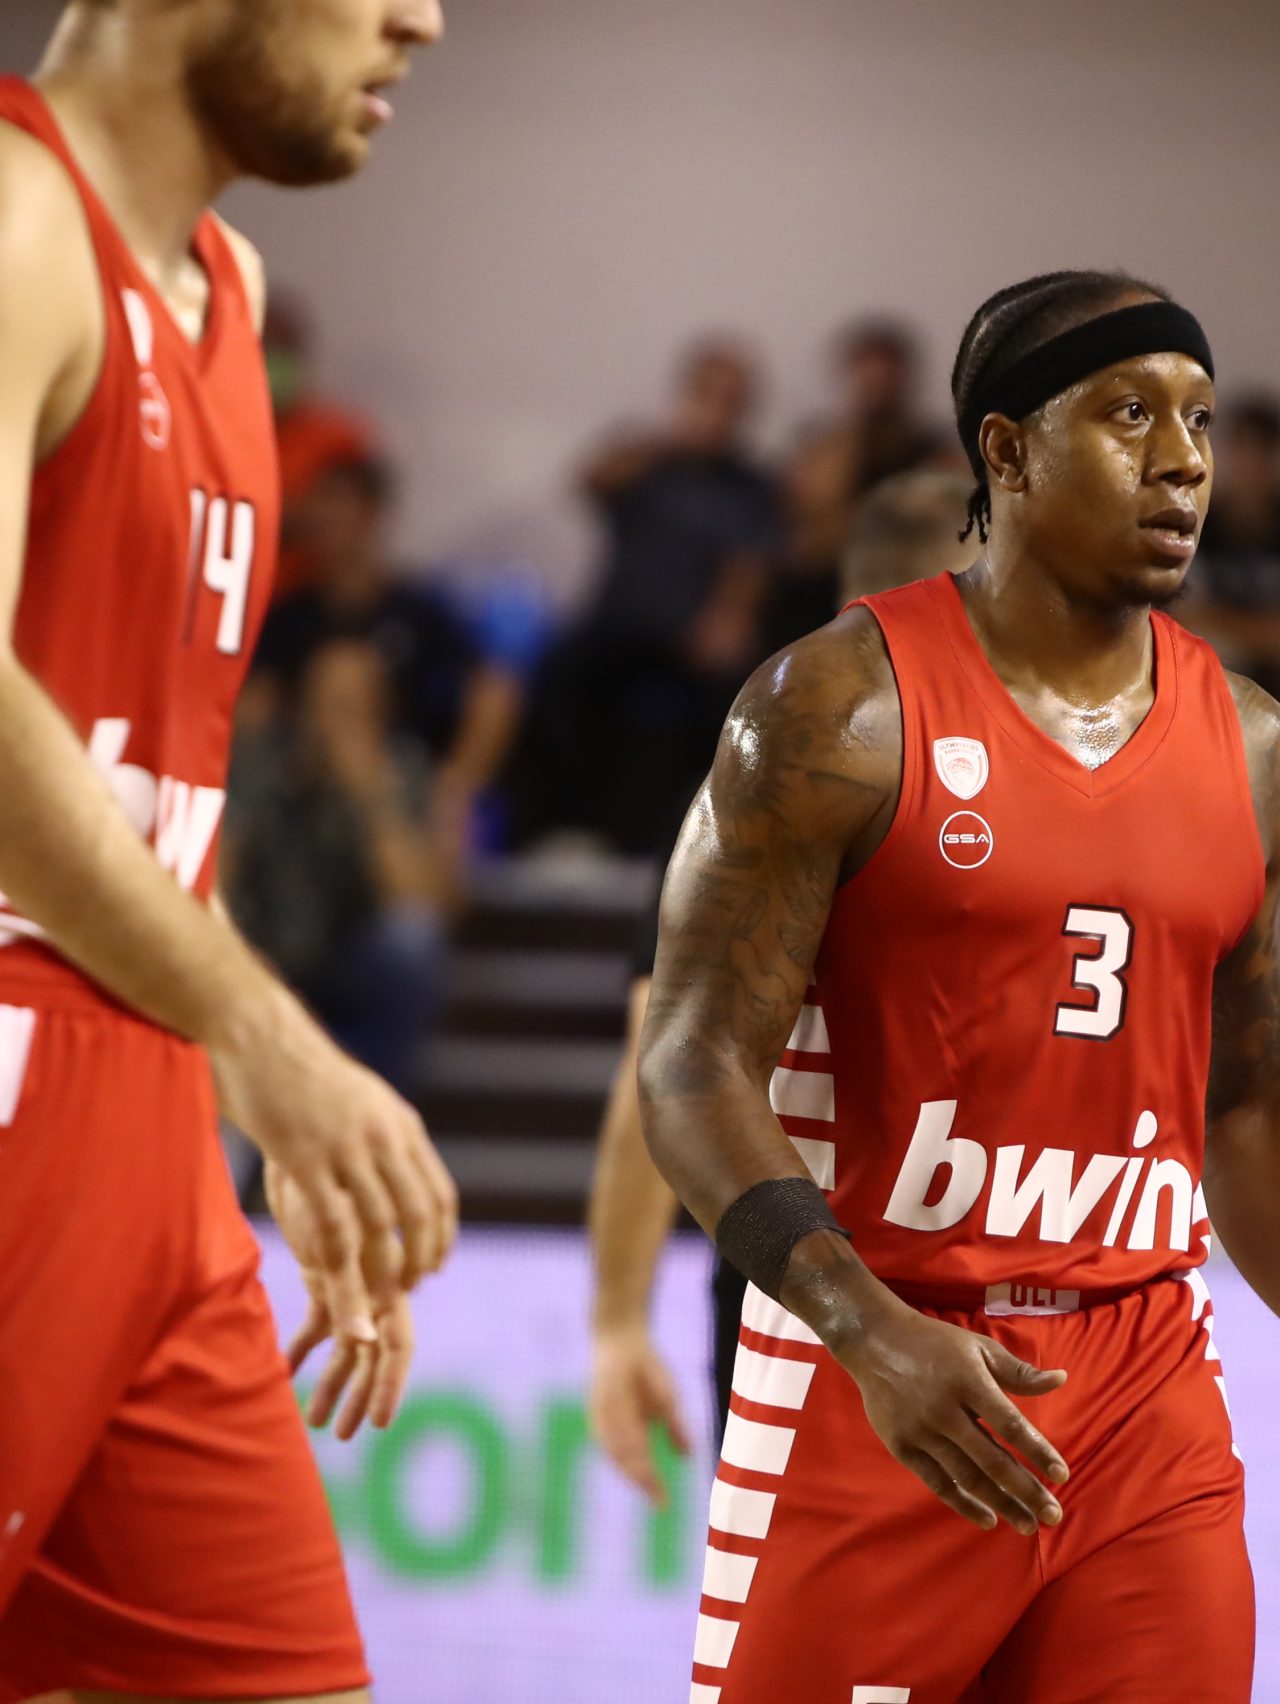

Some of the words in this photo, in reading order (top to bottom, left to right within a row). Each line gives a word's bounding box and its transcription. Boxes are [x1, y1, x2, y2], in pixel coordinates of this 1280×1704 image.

[943, 833, 990, 844] GSA
[1054, 903, 1134, 1042] 3
[882, 1099, 1194, 1253] bwin
[302, 1388, 694, 1588] on
